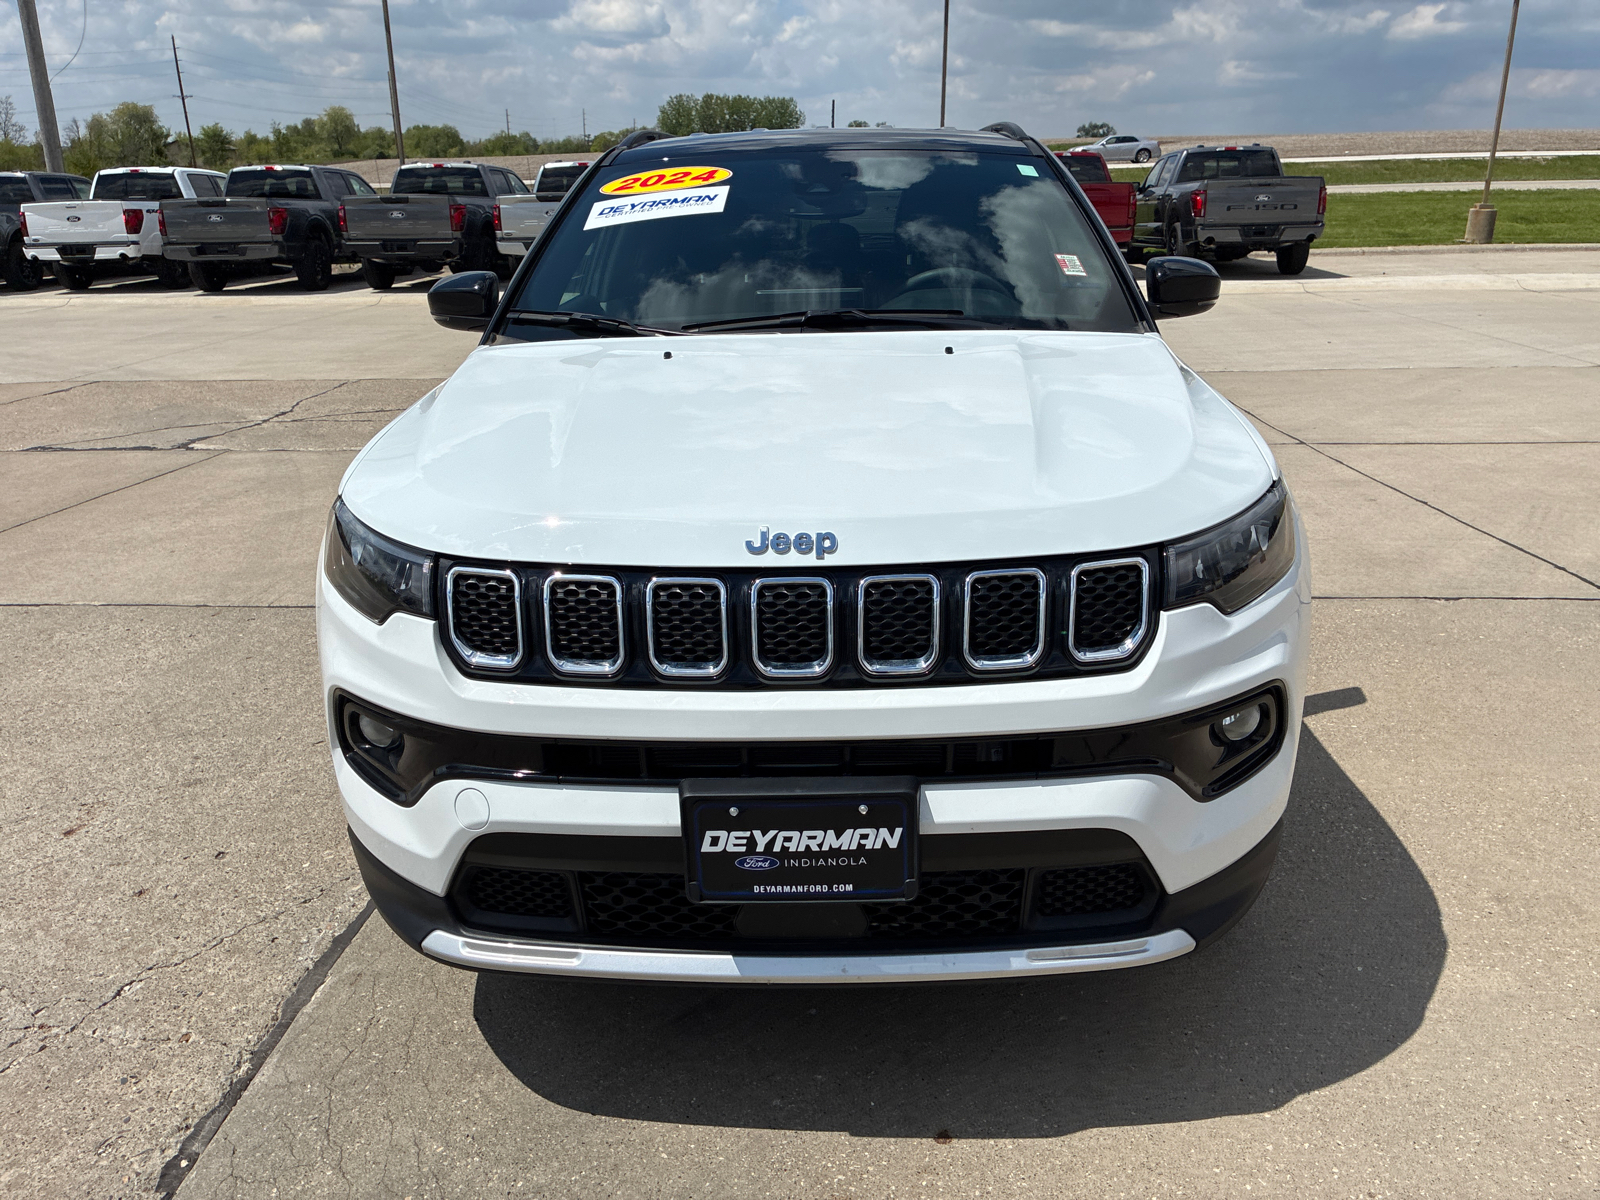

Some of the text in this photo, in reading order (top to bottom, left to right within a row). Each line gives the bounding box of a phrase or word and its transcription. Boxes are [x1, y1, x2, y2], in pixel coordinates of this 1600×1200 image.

[611, 169, 720, 193] 2024
[597, 194, 719, 216] DEYARMAN
[604, 201, 713, 219] CERTIFIED PRE-OWNED
[1226, 203, 1298, 211] F-150
[745, 525, 838, 560] Jeep
[700, 827, 903, 852] DEYARMAN
[744, 857, 868, 868] Ford INDIANOLA
[753, 884, 854, 893] DEYARMANFORD.COM
